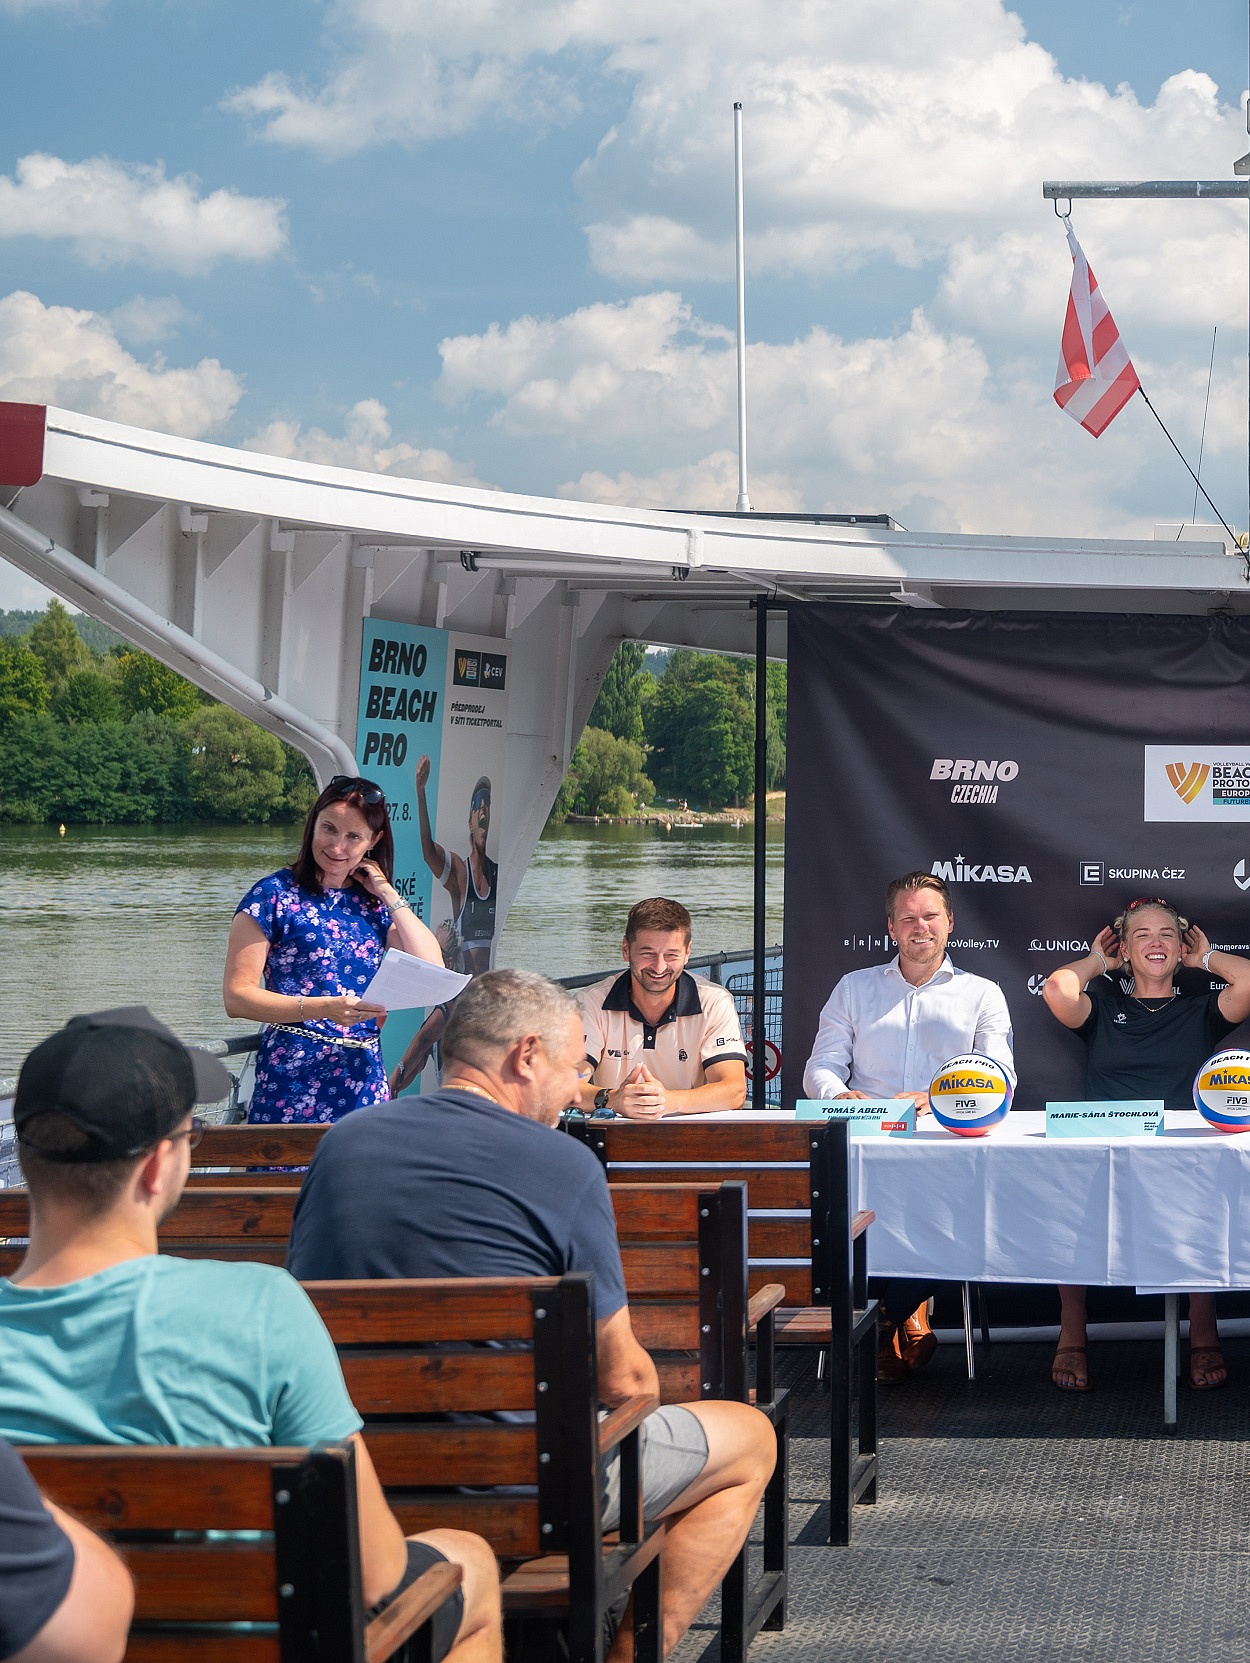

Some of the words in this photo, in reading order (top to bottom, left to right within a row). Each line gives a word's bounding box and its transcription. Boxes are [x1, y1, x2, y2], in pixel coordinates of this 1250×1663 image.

[368, 638, 428, 678] BRNO
[365, 685, 438, 723] BEACH
[450, 715, 455, 725] V
[465, 716, 503, 728] TICKETPORTAL
[362, 731, 408, 767] PRO
[930, 758, 1020, 782] BRNO
[1212, 779, 1235, 788] PRO
[950, 784, 999, 804] CZECHIA
[1108, 868, 1159, 879] SKUPINA
[1161, 866, 1186, 880] ČEZ
[944, 938, 1000, 950] roVolley.TV
[1046, 940, 1091, 952] UNIQA
[940, 1059, 972, 1072] BEACH
[975, 1060, 995, 1070] PRO
[1210, 1055, 1243, 1067] BEACH
[955, 1099, 977, 1108] FIVB
[1226, 1096, 1248, 1104] FIVB
[821, 1105, 856, 1114] TOMÁŠ
[1050, 1111, 1106, 1119] MARIE-SÁRA
[1107, 1110, 1160, 1118] ŠTOCHLOVÁ
